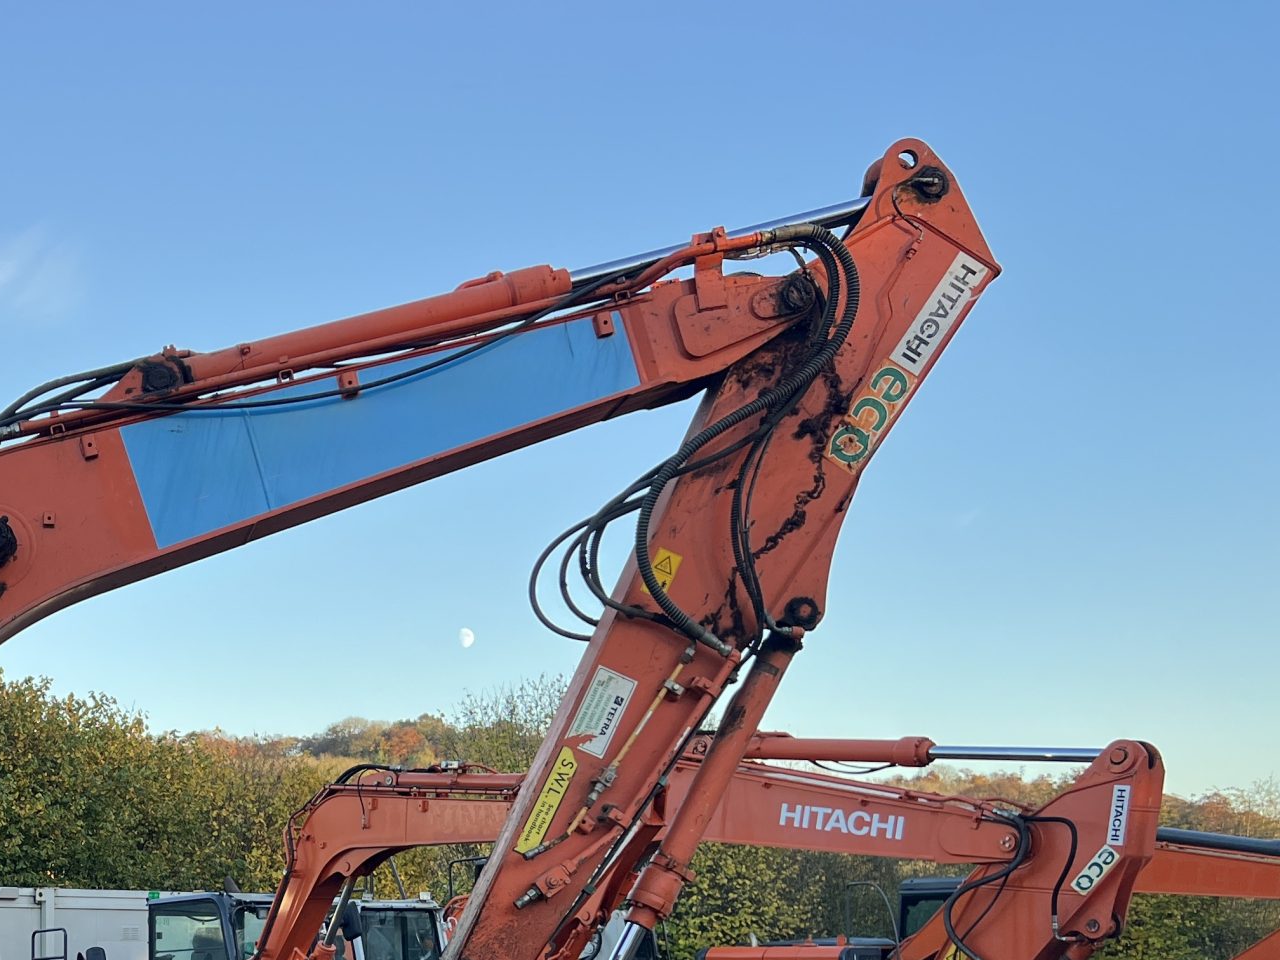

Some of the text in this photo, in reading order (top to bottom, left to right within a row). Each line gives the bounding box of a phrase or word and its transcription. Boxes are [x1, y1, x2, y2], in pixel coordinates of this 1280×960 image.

[901, 263, 978, 365] HITACHI
[598, 704, 618, 737] TEFRA
[523, 808, 544, 842] handbook
[535, 802, 554, 836] See chart
[779, 803, 905, 840] HITACHI
[1110, 788, 1126, 841] HITACHI
